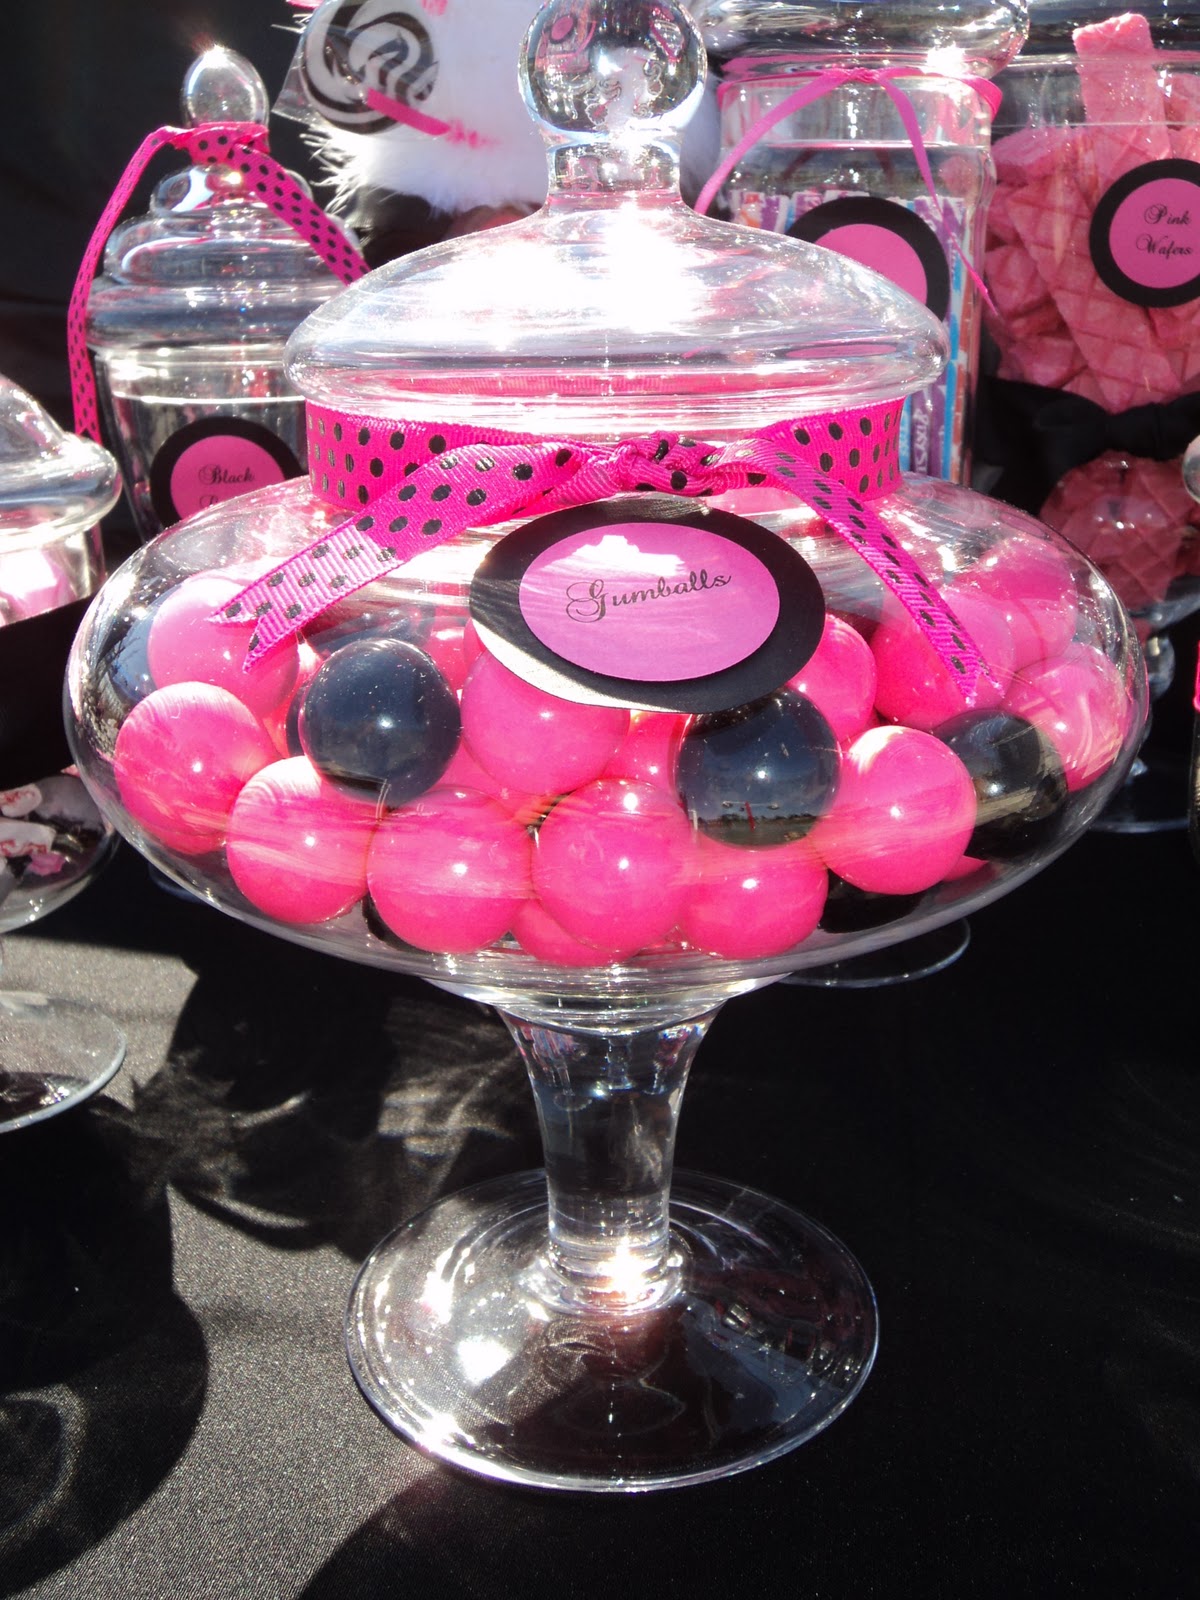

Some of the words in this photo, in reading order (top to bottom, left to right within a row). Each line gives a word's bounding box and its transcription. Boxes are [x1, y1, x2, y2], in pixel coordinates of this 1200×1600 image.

[1144, 204, 1190, 225] Pink
[1136, 233, 1193, 259] Wafers
[199, 464, 254, 485] Black
[566, 569, 731, 623] Gumballs
